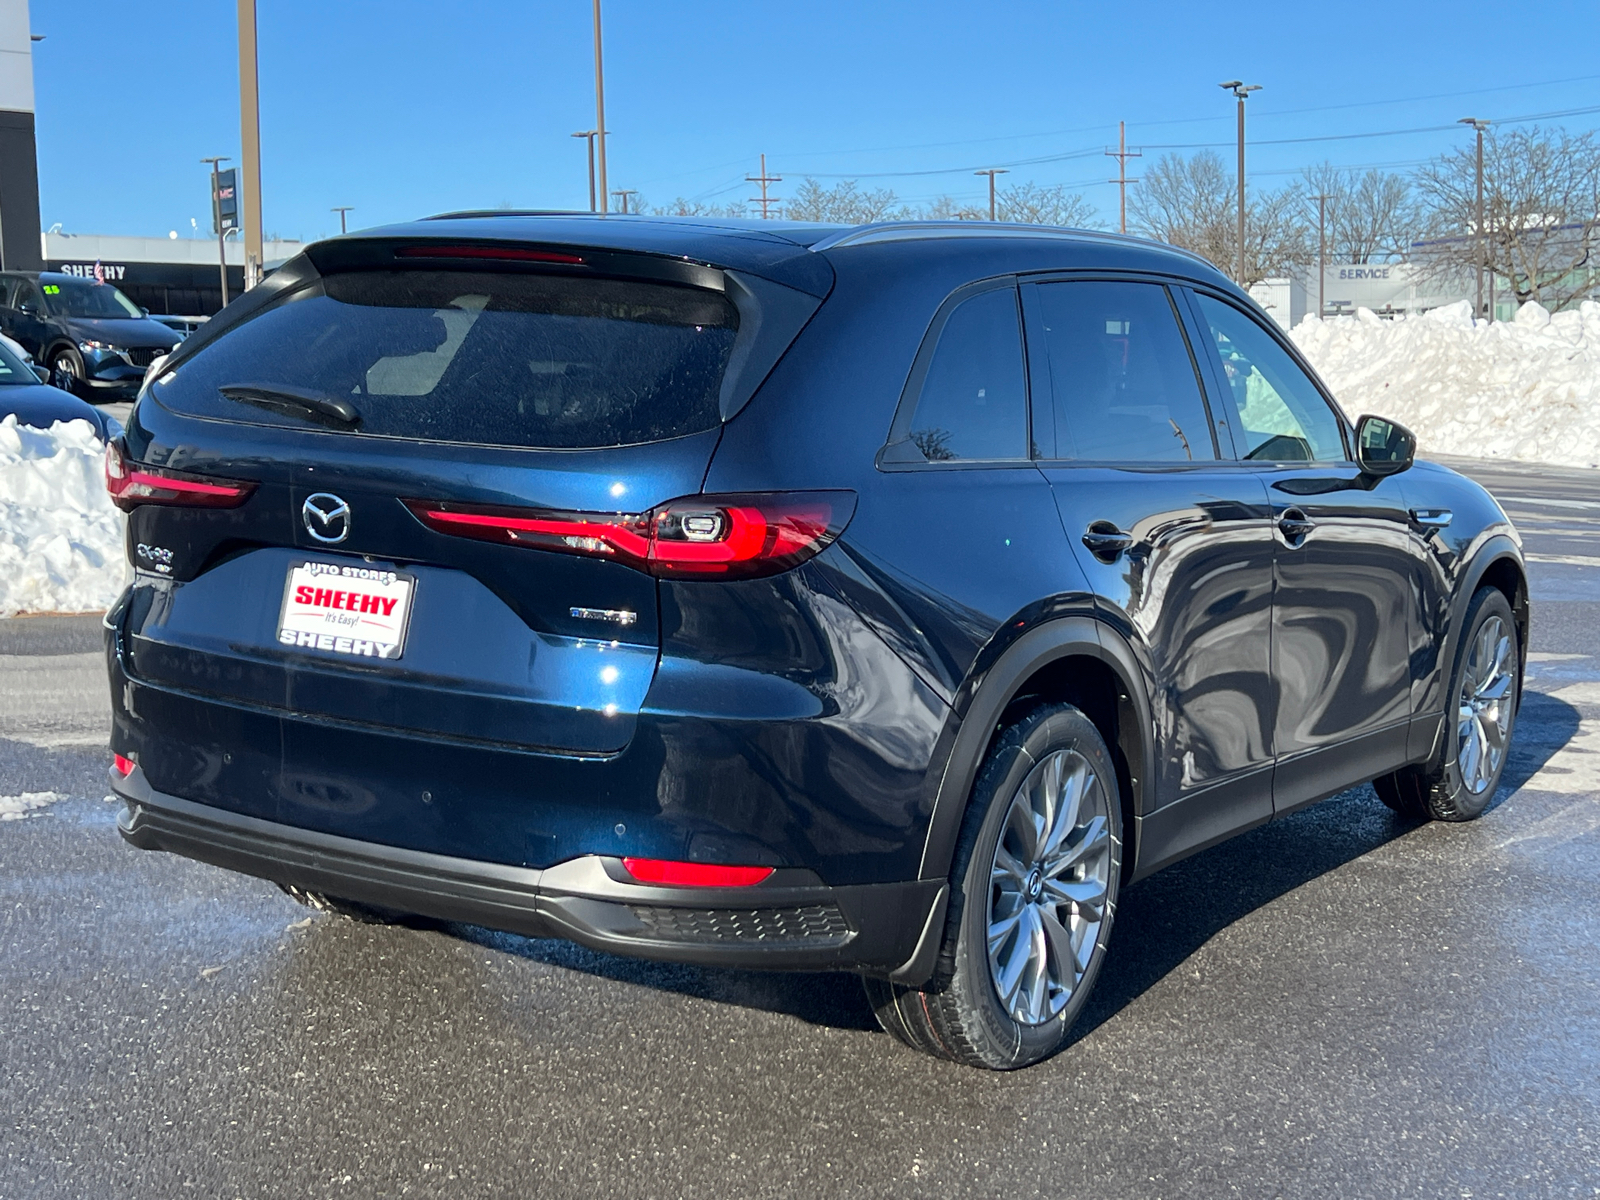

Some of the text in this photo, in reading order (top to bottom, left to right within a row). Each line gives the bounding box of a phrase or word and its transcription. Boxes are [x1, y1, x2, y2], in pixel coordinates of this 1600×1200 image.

[61, 264, 125, 280] SHEHY
[1340, 268, 1390, 279] SERVICE
[303, 561, 340, 576] AUTO
[295, 585, 398, 617] SHEEHY
[324, 612, 360, 628] It's Easy!
[279, 629, 397, 659] SHEEHY
